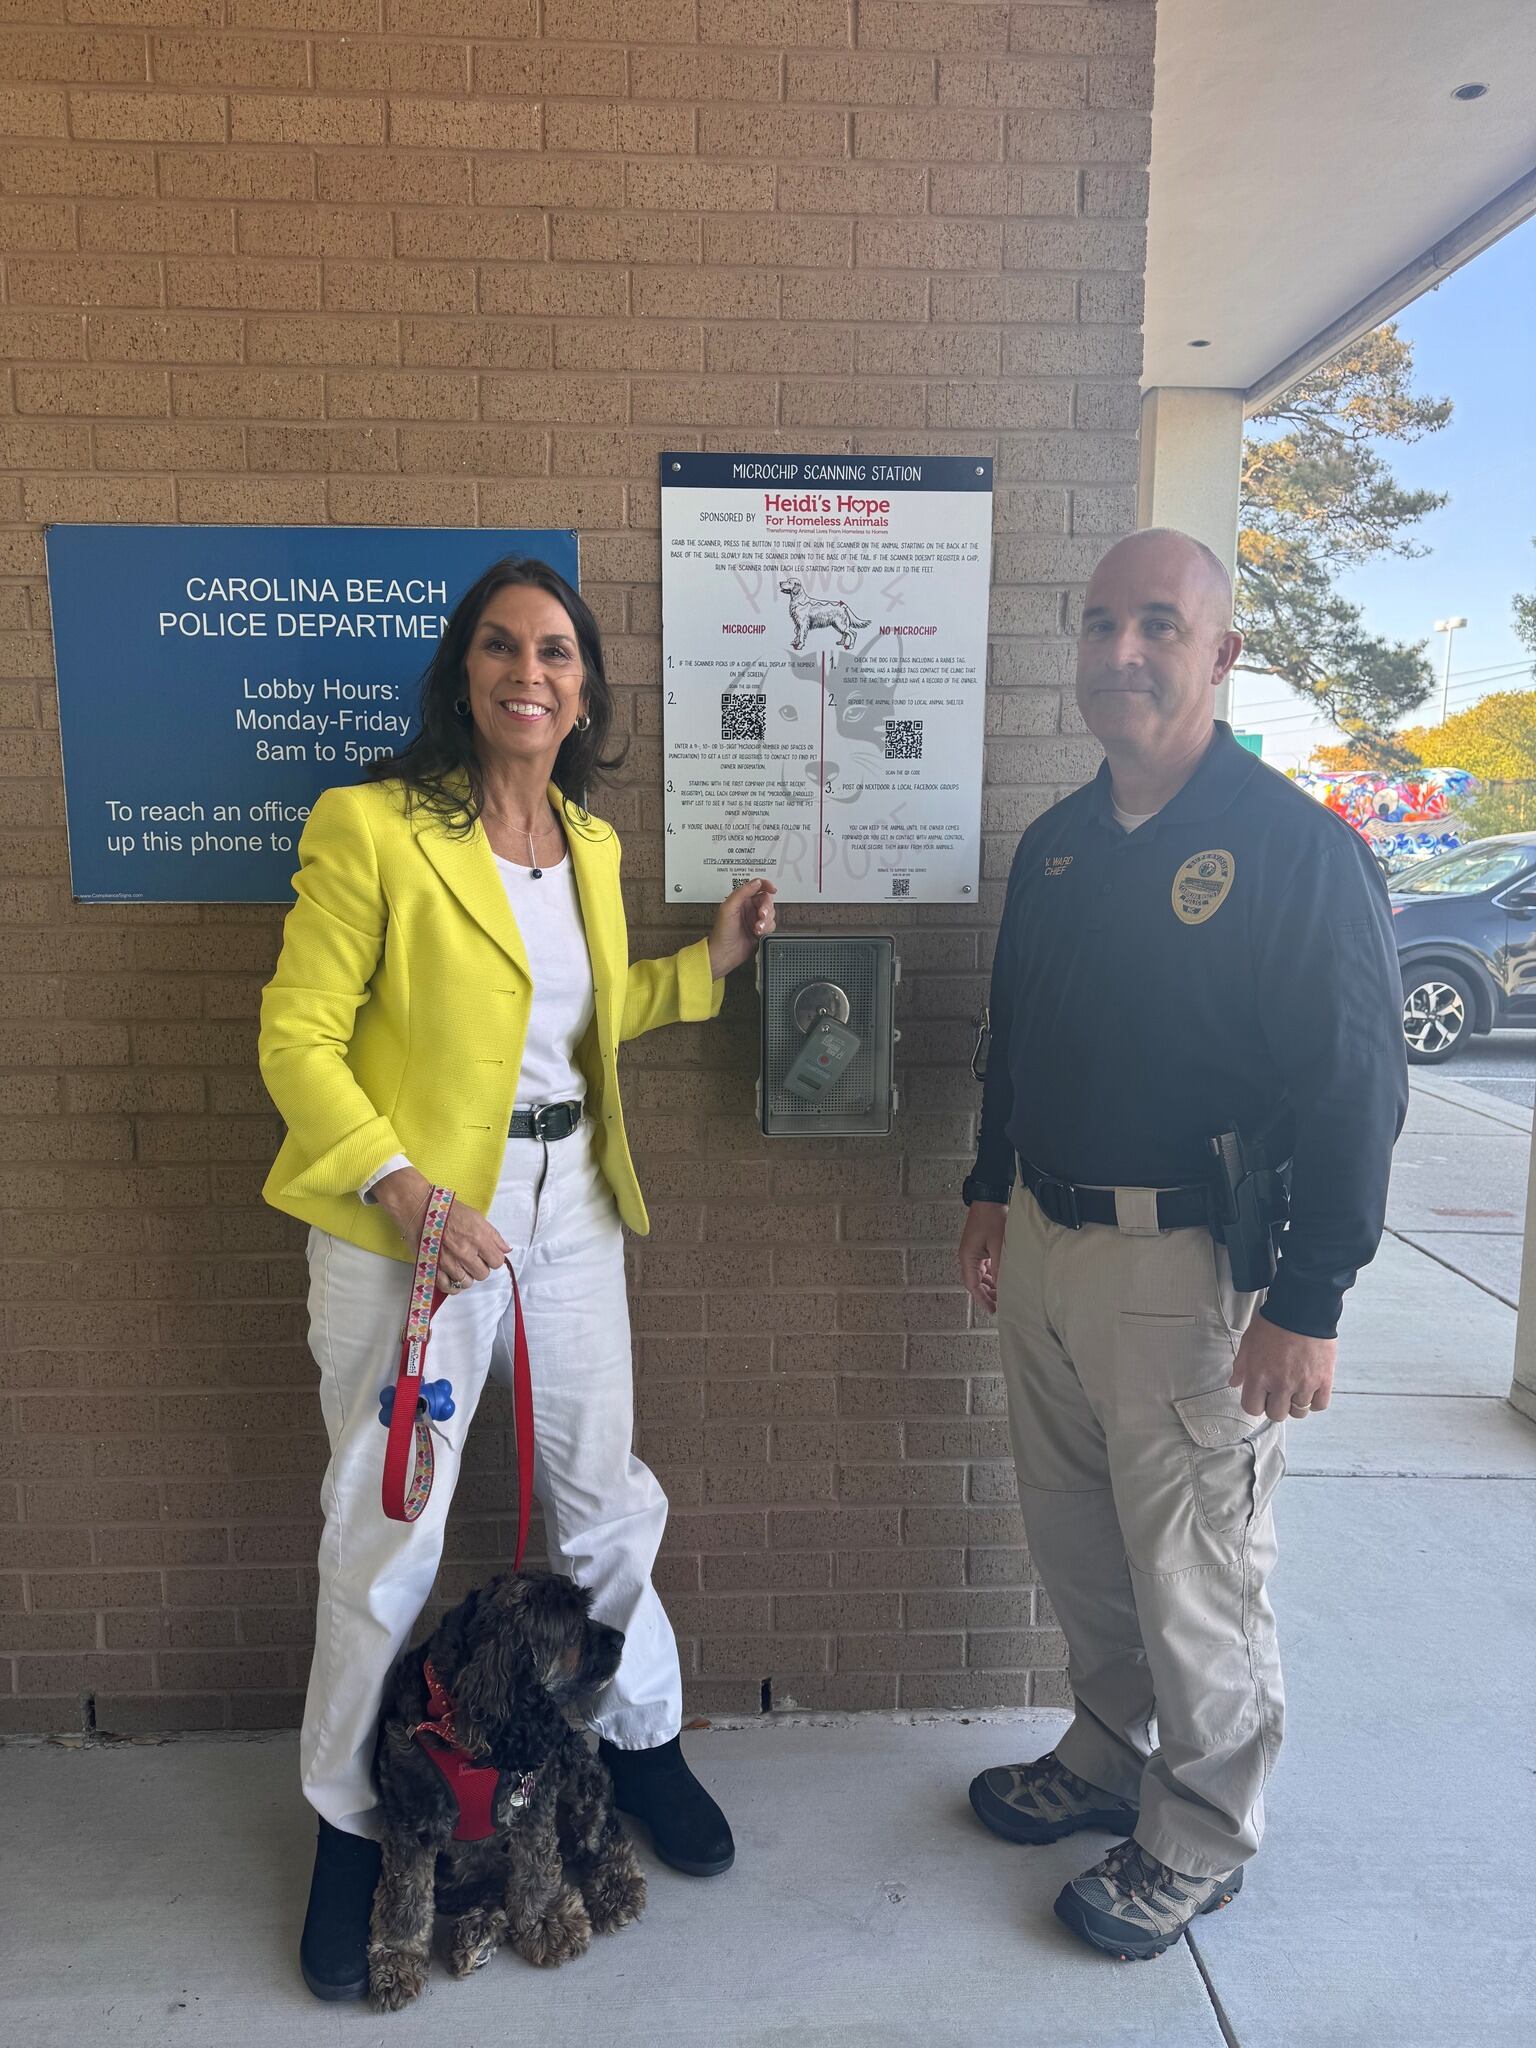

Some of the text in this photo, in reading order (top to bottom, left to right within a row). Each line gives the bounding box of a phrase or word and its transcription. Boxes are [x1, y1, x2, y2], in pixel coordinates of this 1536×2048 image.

[733, 464, 922, 482] MICROCHIP SCANNING STATION
[764, 494, 890, 516] Heidi's Hope
[699, 512, 756, 523] SPONSORED BY
[765, 515, 889, 527] For Homeless Animals
[186, 577, 447, 604] CAROLINA BEACH
[159, 612, 450, 639] POLICE DEPARTMEN
[722, 624, 766, 634] MICROCHIP
[879, 626, 937, 636] NO MICROCHIP
[667, 656, 674, 668] 1.
[830, 656, 836, 670] 1.
[243, 678, 400, 704] Lobby Hours:
[668, 692, 676, 704] 2.
[828, 694, 837, 706] 2.
[235, 708, 411, 736] Monday-Friday
[256, 740, 394, 767] 8am to 5pm
[666, 780, 676, 792] 3.
[825, 781, 834, 794] 3.
[105, 801, 133, 821] To
[140, 801, 204, 822] reach
[213, 806, 240, 822] an
[666, 822, 676, 834] 4.
[824, 824, 834, 836] 4.
[107, 832, 292, 856] up this phone to
